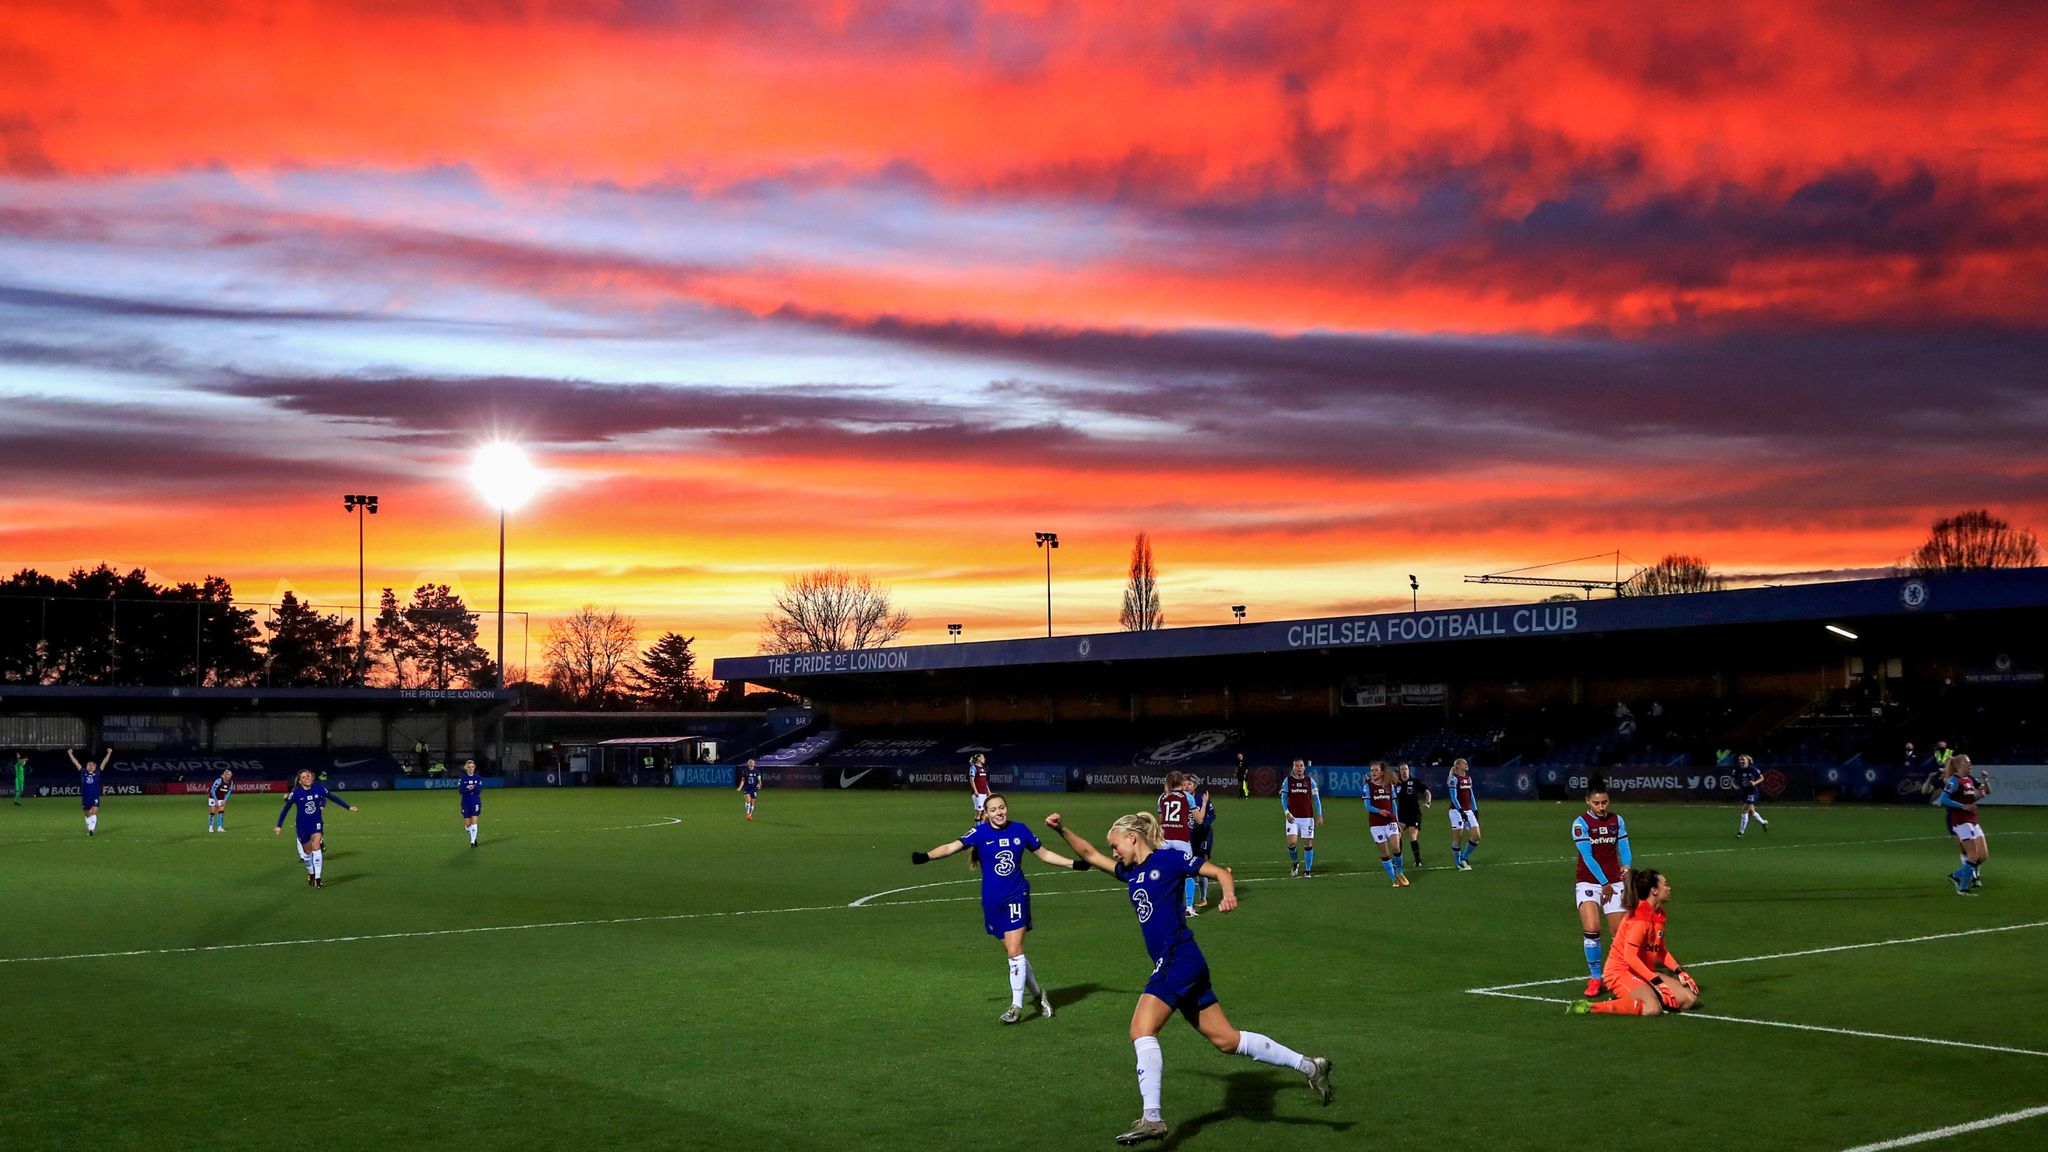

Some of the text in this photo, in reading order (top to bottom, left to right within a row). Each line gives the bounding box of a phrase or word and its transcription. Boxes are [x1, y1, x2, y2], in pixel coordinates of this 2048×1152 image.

[1288, 606, 1578, 647] CHELSEA FOOTBALL CLUB
[768, 651, 908, 675] THE PRIDE OF LONDON
[400, 690, 418, 698] THE
[419, 690, 445, 698] PRIDE
[457, 690, 495, 698] LONDON
[795, 717, 807, 726] BAR
[112, 759, 265, 772] CHAMPIONS
[687, 767, 733, 784] BARCLAYS
[915, 774, 969, 783] BARCLAYS FA WSL
[1093, 774, 1166, 785] BARCLAYS FA Wome
[1206, 775, 1239, 788] League
[236, 783, 272, 791] INSURANCE
[434, 779, 459, 788] BARC
[1568, 776, 1683, 792] @BclaysFAWSL
[51, 785, 144, 796] BARCL FA WSL
[1163, 800, 1182, 822] 12
[1589, 836, 1618, 845] betway
[1008, 902, 1023, 919] 14
